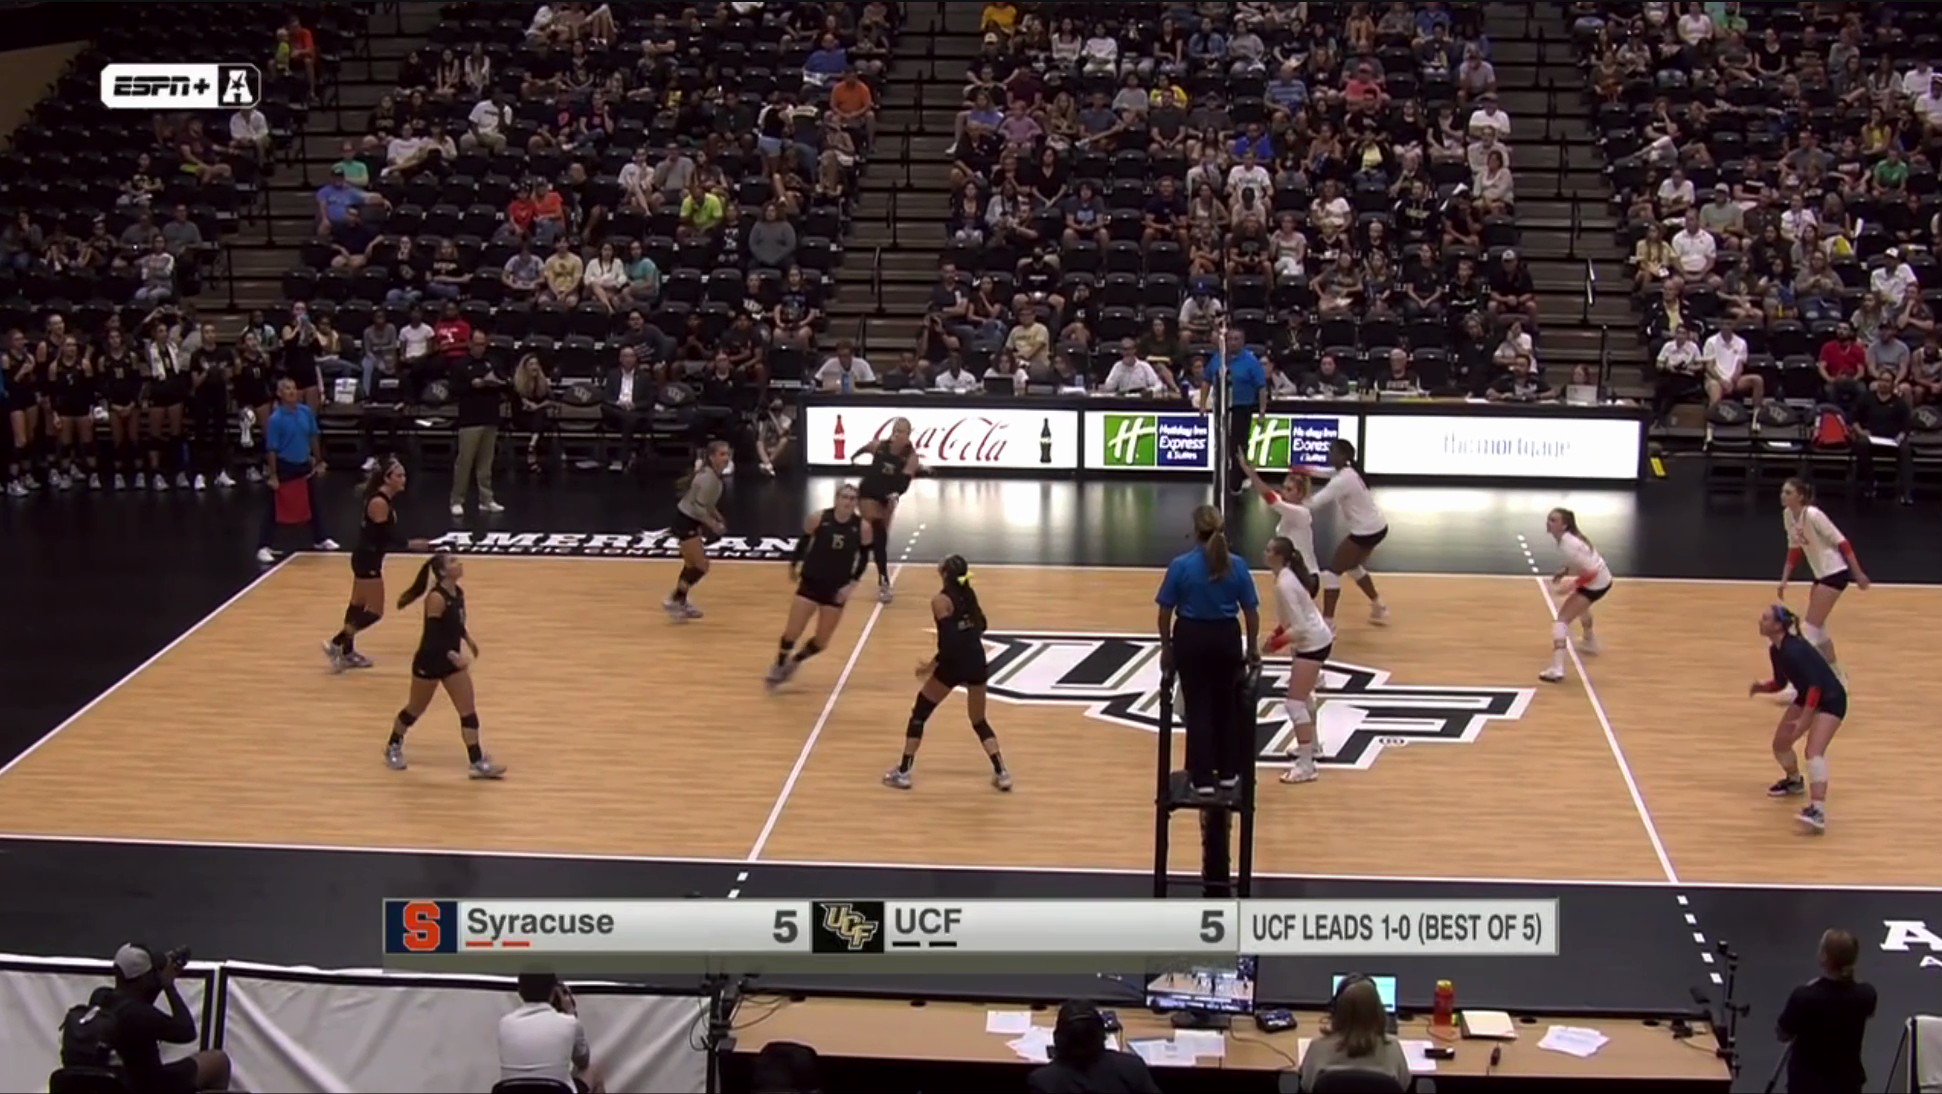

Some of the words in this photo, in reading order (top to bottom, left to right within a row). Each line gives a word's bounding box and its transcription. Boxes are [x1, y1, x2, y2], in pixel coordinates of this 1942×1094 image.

[1194, 425, 1208, 436] Inn
[1292, 427, 1322, 439] Hoday
[874, 416, 1009, 462] Ca-Cola
[1159, 436, 1207, 450] Express
[1292, 438, 1331, 452] Expres
[583, 546, 784, 558] CONFEENCE
